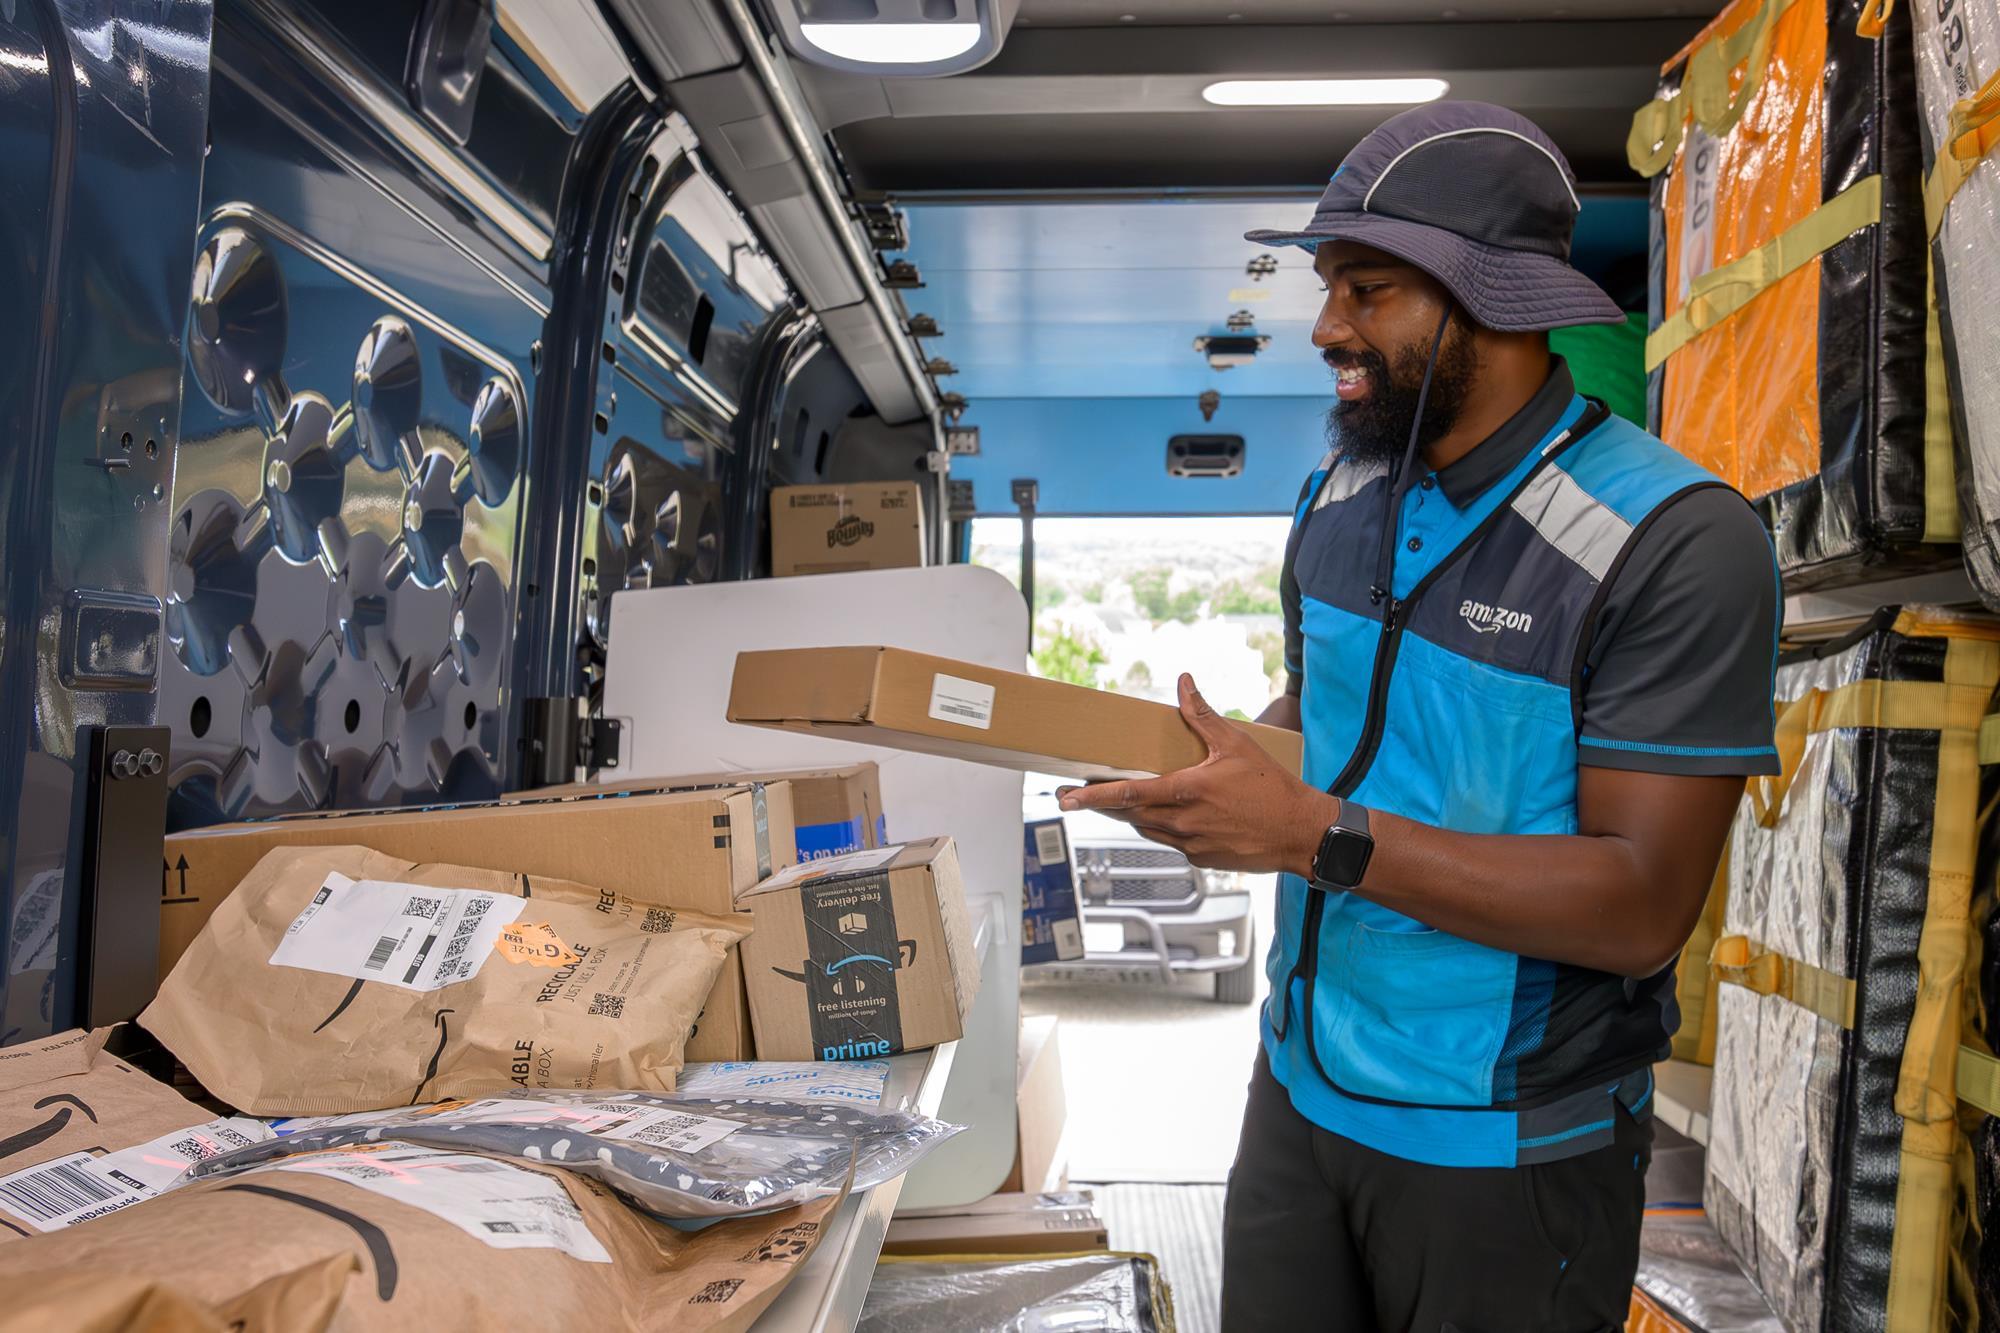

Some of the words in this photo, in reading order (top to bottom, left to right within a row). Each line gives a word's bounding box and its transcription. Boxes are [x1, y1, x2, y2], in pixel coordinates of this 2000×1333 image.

[827, 520, 875, 549] Bounty
[813, 848, 832, 861] on
[817, 896, 858, 908] delivery
[860, 892, 882, 902] free
[544, 943, 560, 958] G
[563, 984, 583, 1002] JUST
[576, 969, 594, 985] LIKE
[590, 947, 608, 965] BOX
[817, 1002, 838, 1012] free
[840, 996, 886, 1010] listening
[828, 1012, 852, 1020] millions
[823, 1038, 890, 1063] prime
[538, 1047, 554, 1078] BOX
